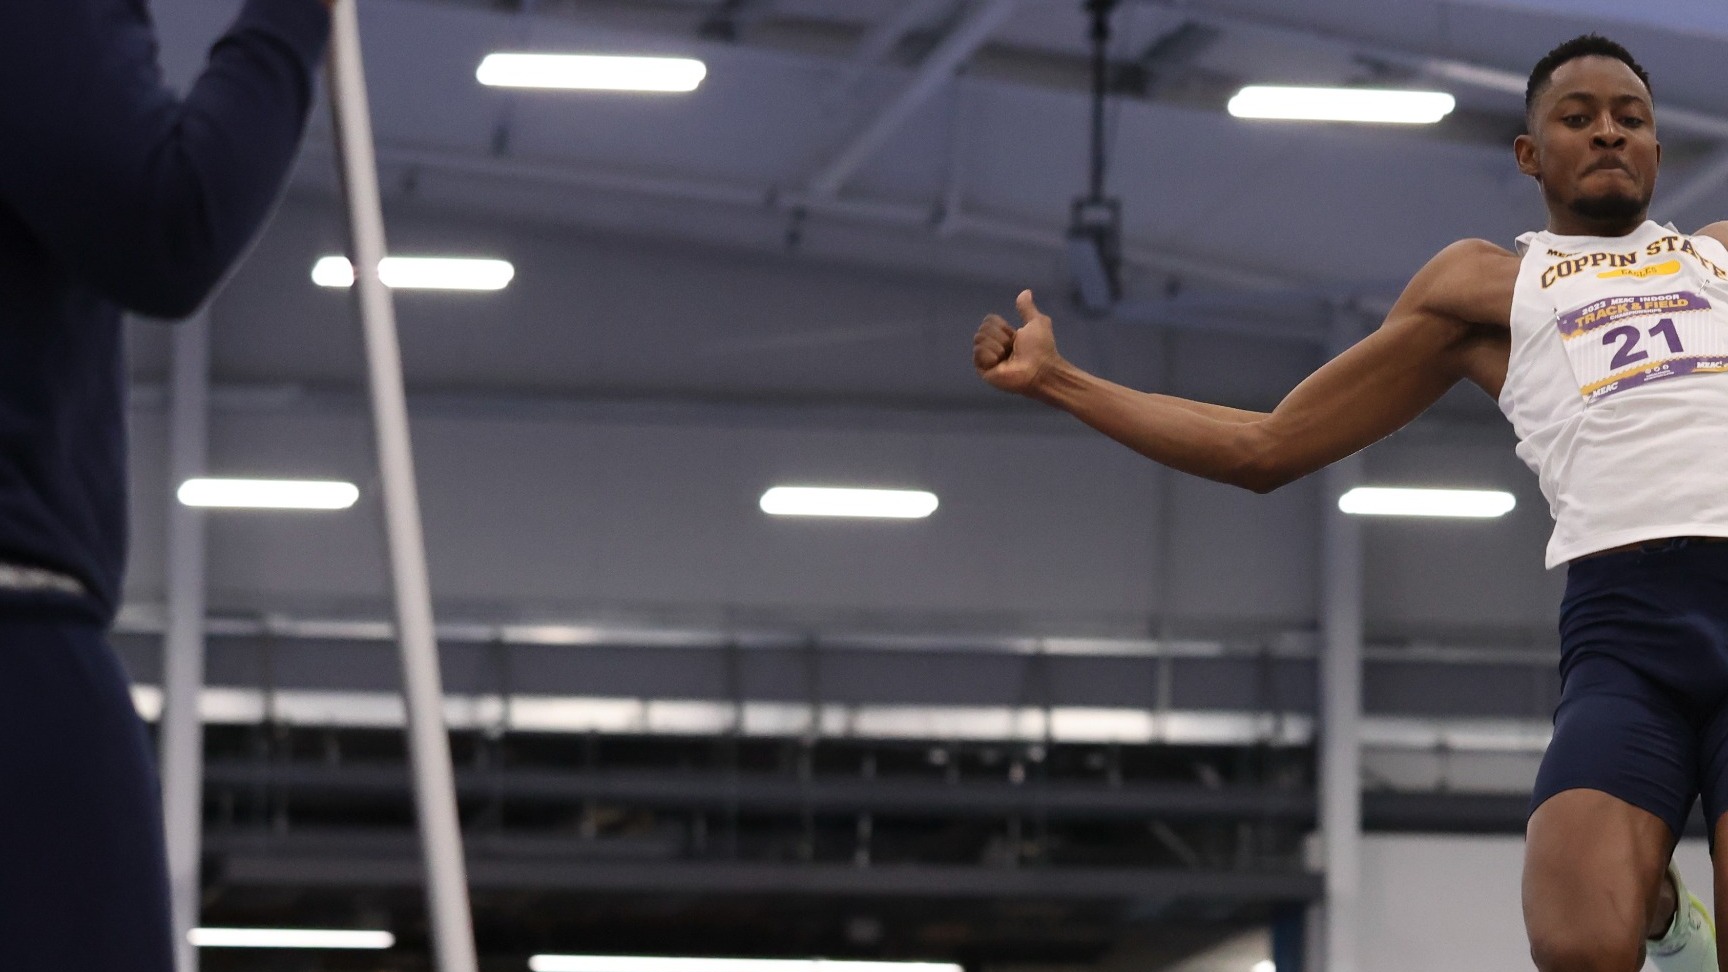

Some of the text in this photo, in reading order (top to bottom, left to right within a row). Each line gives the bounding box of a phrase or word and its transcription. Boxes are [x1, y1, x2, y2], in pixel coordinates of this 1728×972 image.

[1540, 251, 1637, 289] COPPIN
[1574, 299, 1689, 327] TRACK & FIELD
[1581, 293, 1680, 316] 2023 MEAC INDOOR
[1601, 318, 1684, 371] 21
[1592, 382, 1619, 398] MEAC
